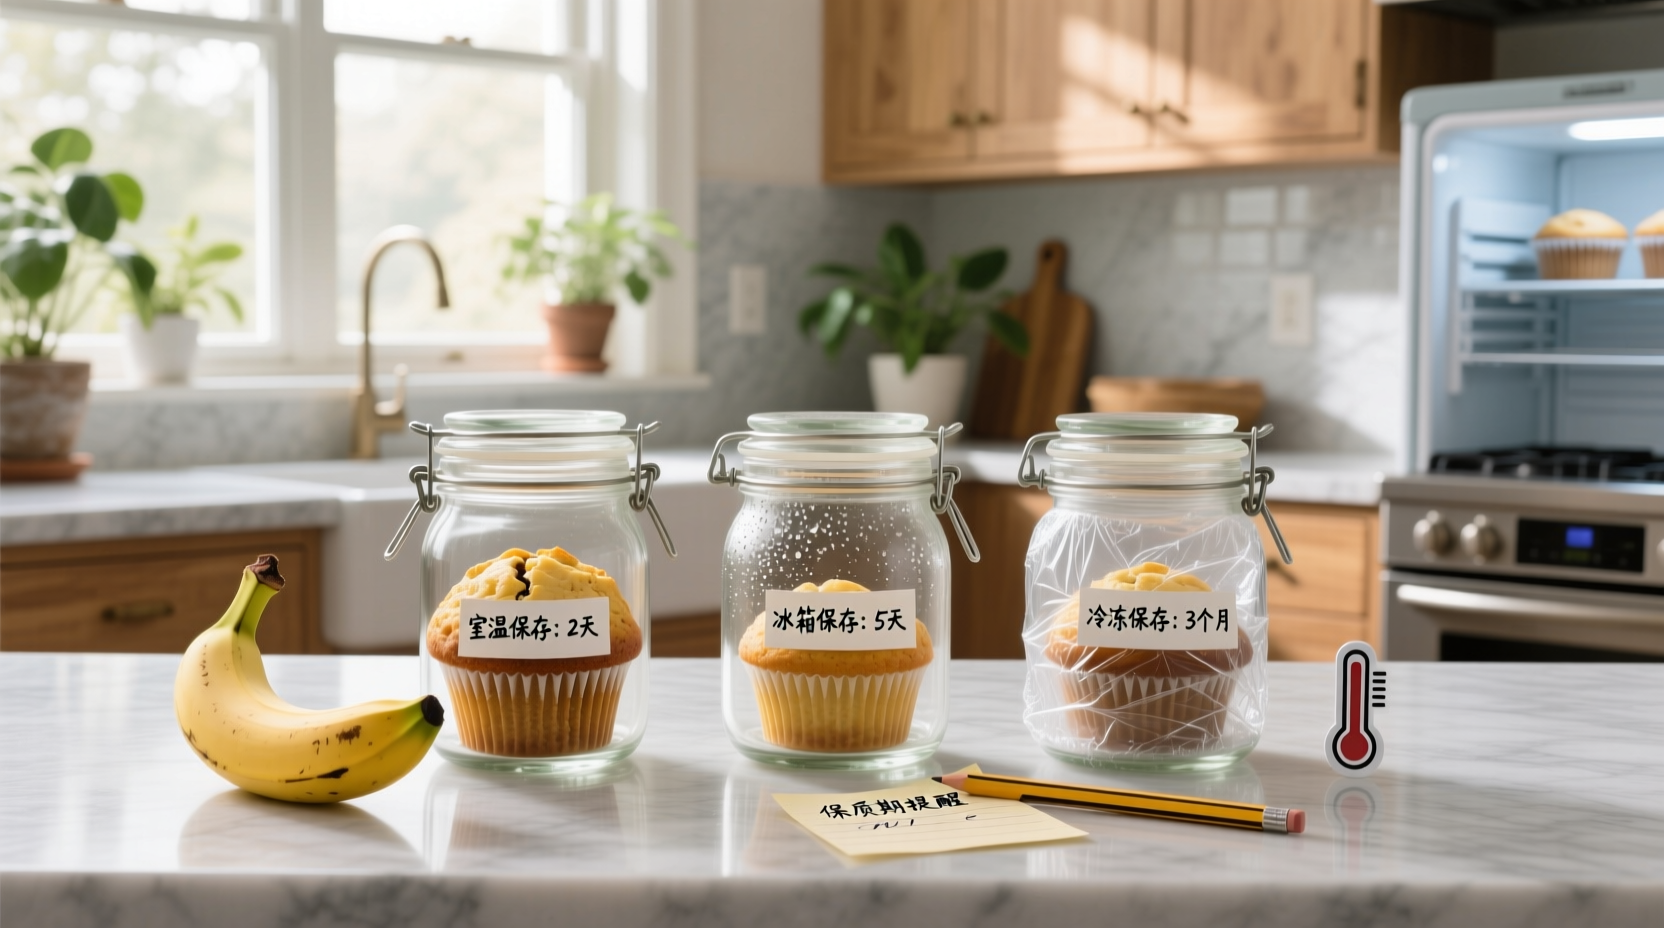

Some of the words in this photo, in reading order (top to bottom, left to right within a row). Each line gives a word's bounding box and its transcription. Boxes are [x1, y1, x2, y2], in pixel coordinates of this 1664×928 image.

[819, 791, 969, 820] 保质期提醒
